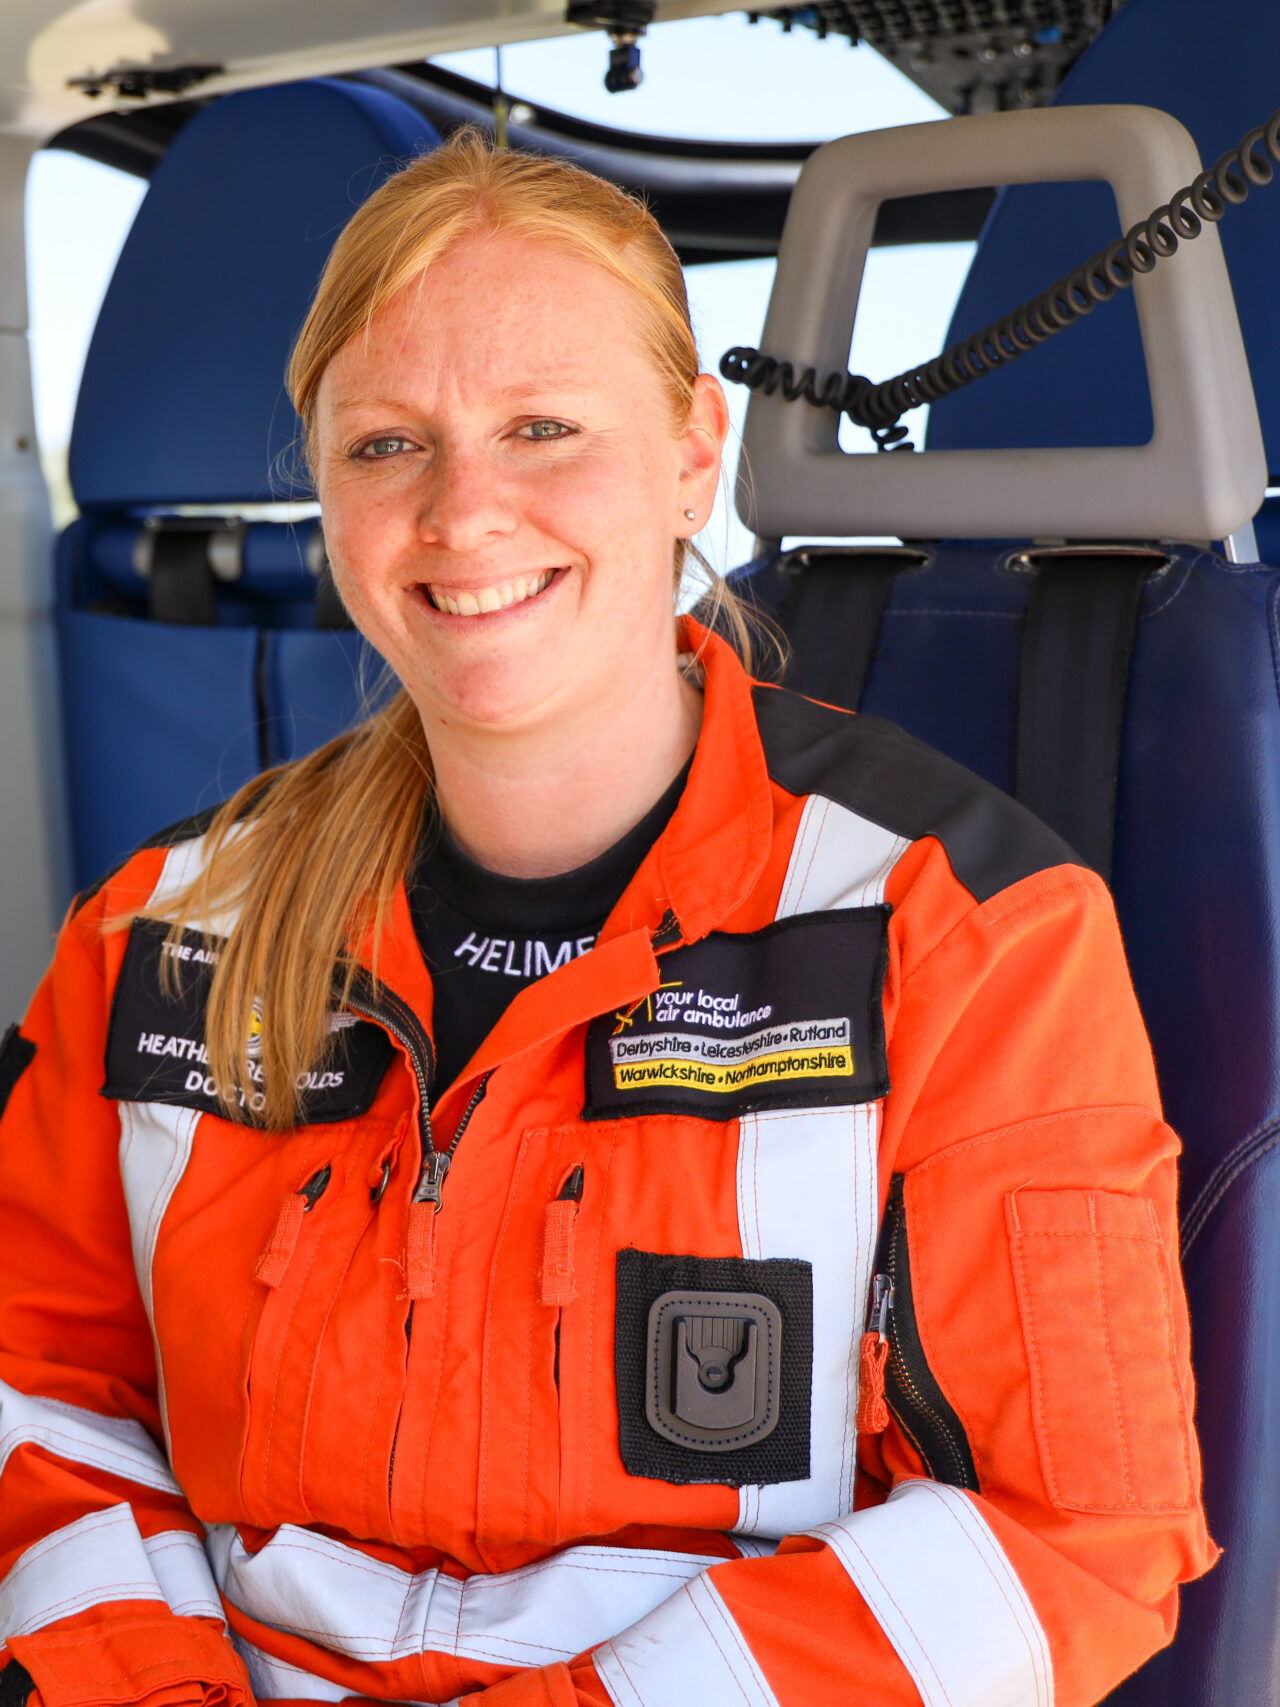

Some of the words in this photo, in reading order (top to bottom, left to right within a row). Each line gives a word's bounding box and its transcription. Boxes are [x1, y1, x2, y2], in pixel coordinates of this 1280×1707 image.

[162, 941, 193, 961] THE
[453, 931, 601, 977] HELIME
[655, 991, 694, 1009] your
[697, 989, 739, 1012] local
[655, 1004, 680, 1022] air
[683, 1005, 772, 1029] ambulance
[137, 1032, 209, 1064] HEATH
[616, 1036, 692, 1057] Derbyshire
[701, 1030, 782, 1058] Leicestershire
[789, 1022, 847, 1042] Rutland
[620, 1064, 716, 1084] Warwickshire
[725, 1052, 847, 1085] Northamptonshire
[184, 1070, 266, 1111] DOCTO
